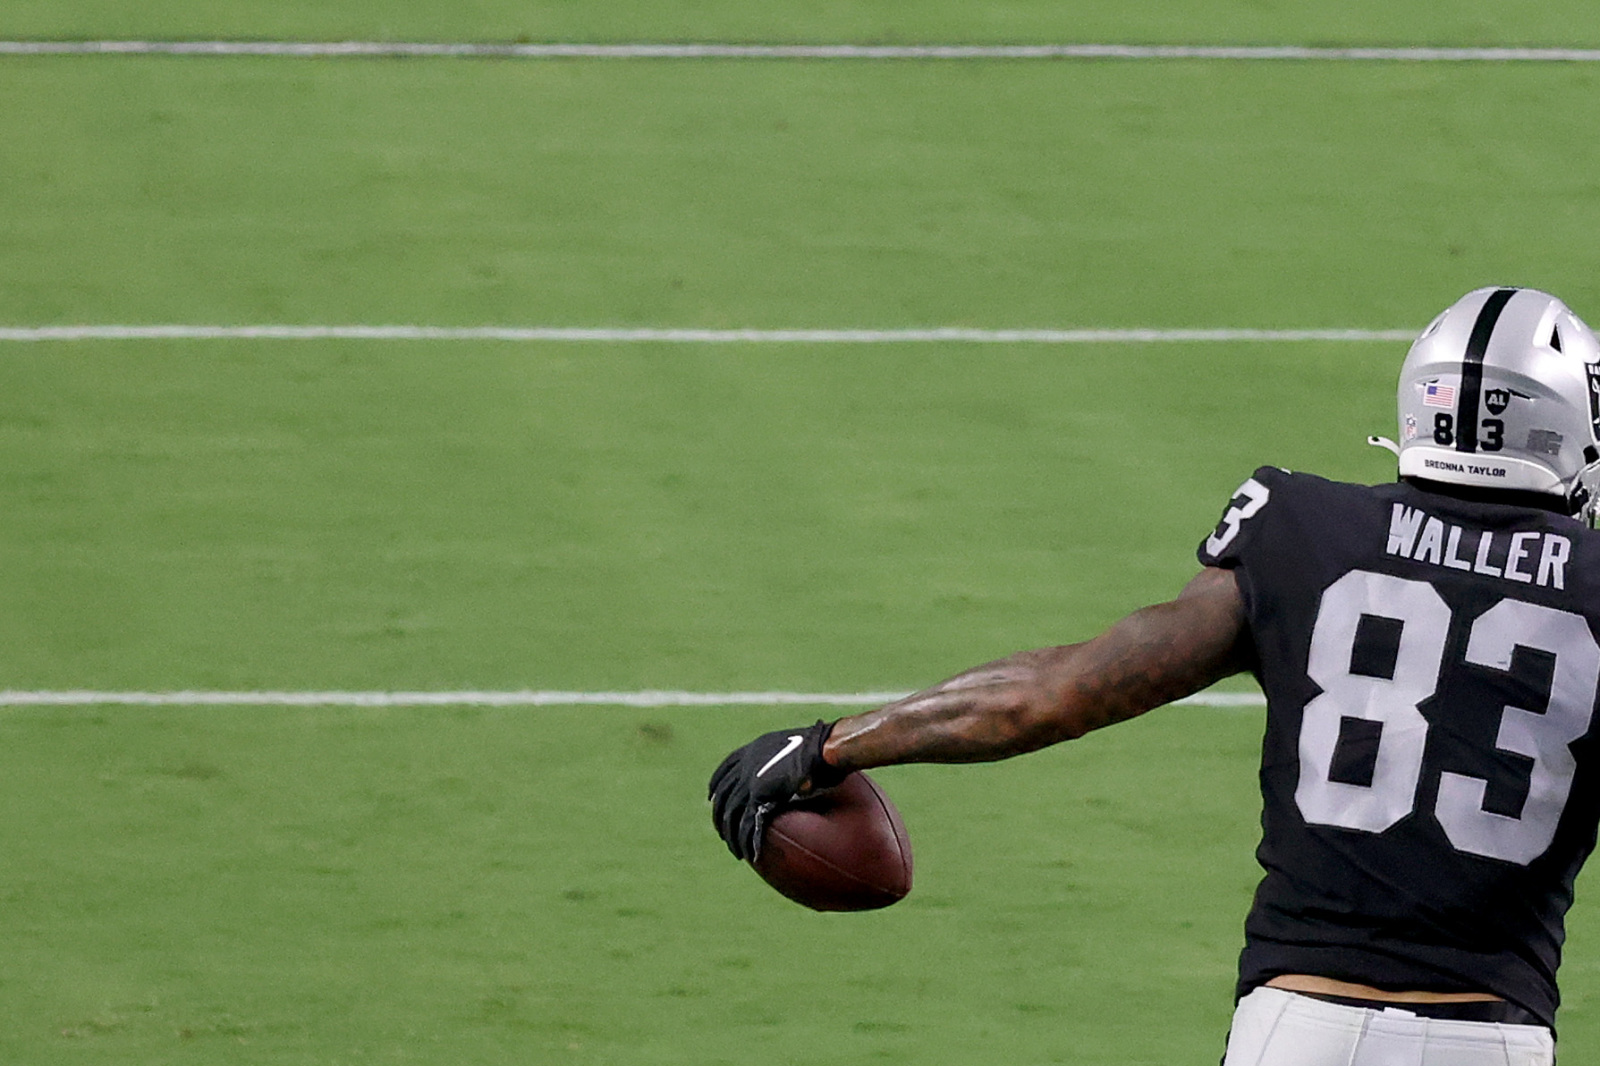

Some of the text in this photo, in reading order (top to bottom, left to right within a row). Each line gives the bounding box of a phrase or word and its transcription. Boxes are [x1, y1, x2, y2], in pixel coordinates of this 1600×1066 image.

[1488, 394, 1506, 407] AL
[1424, 459, 1506, 478] BREONNA TAYLOR
[1386, 503, 1572, 590] WALLER
